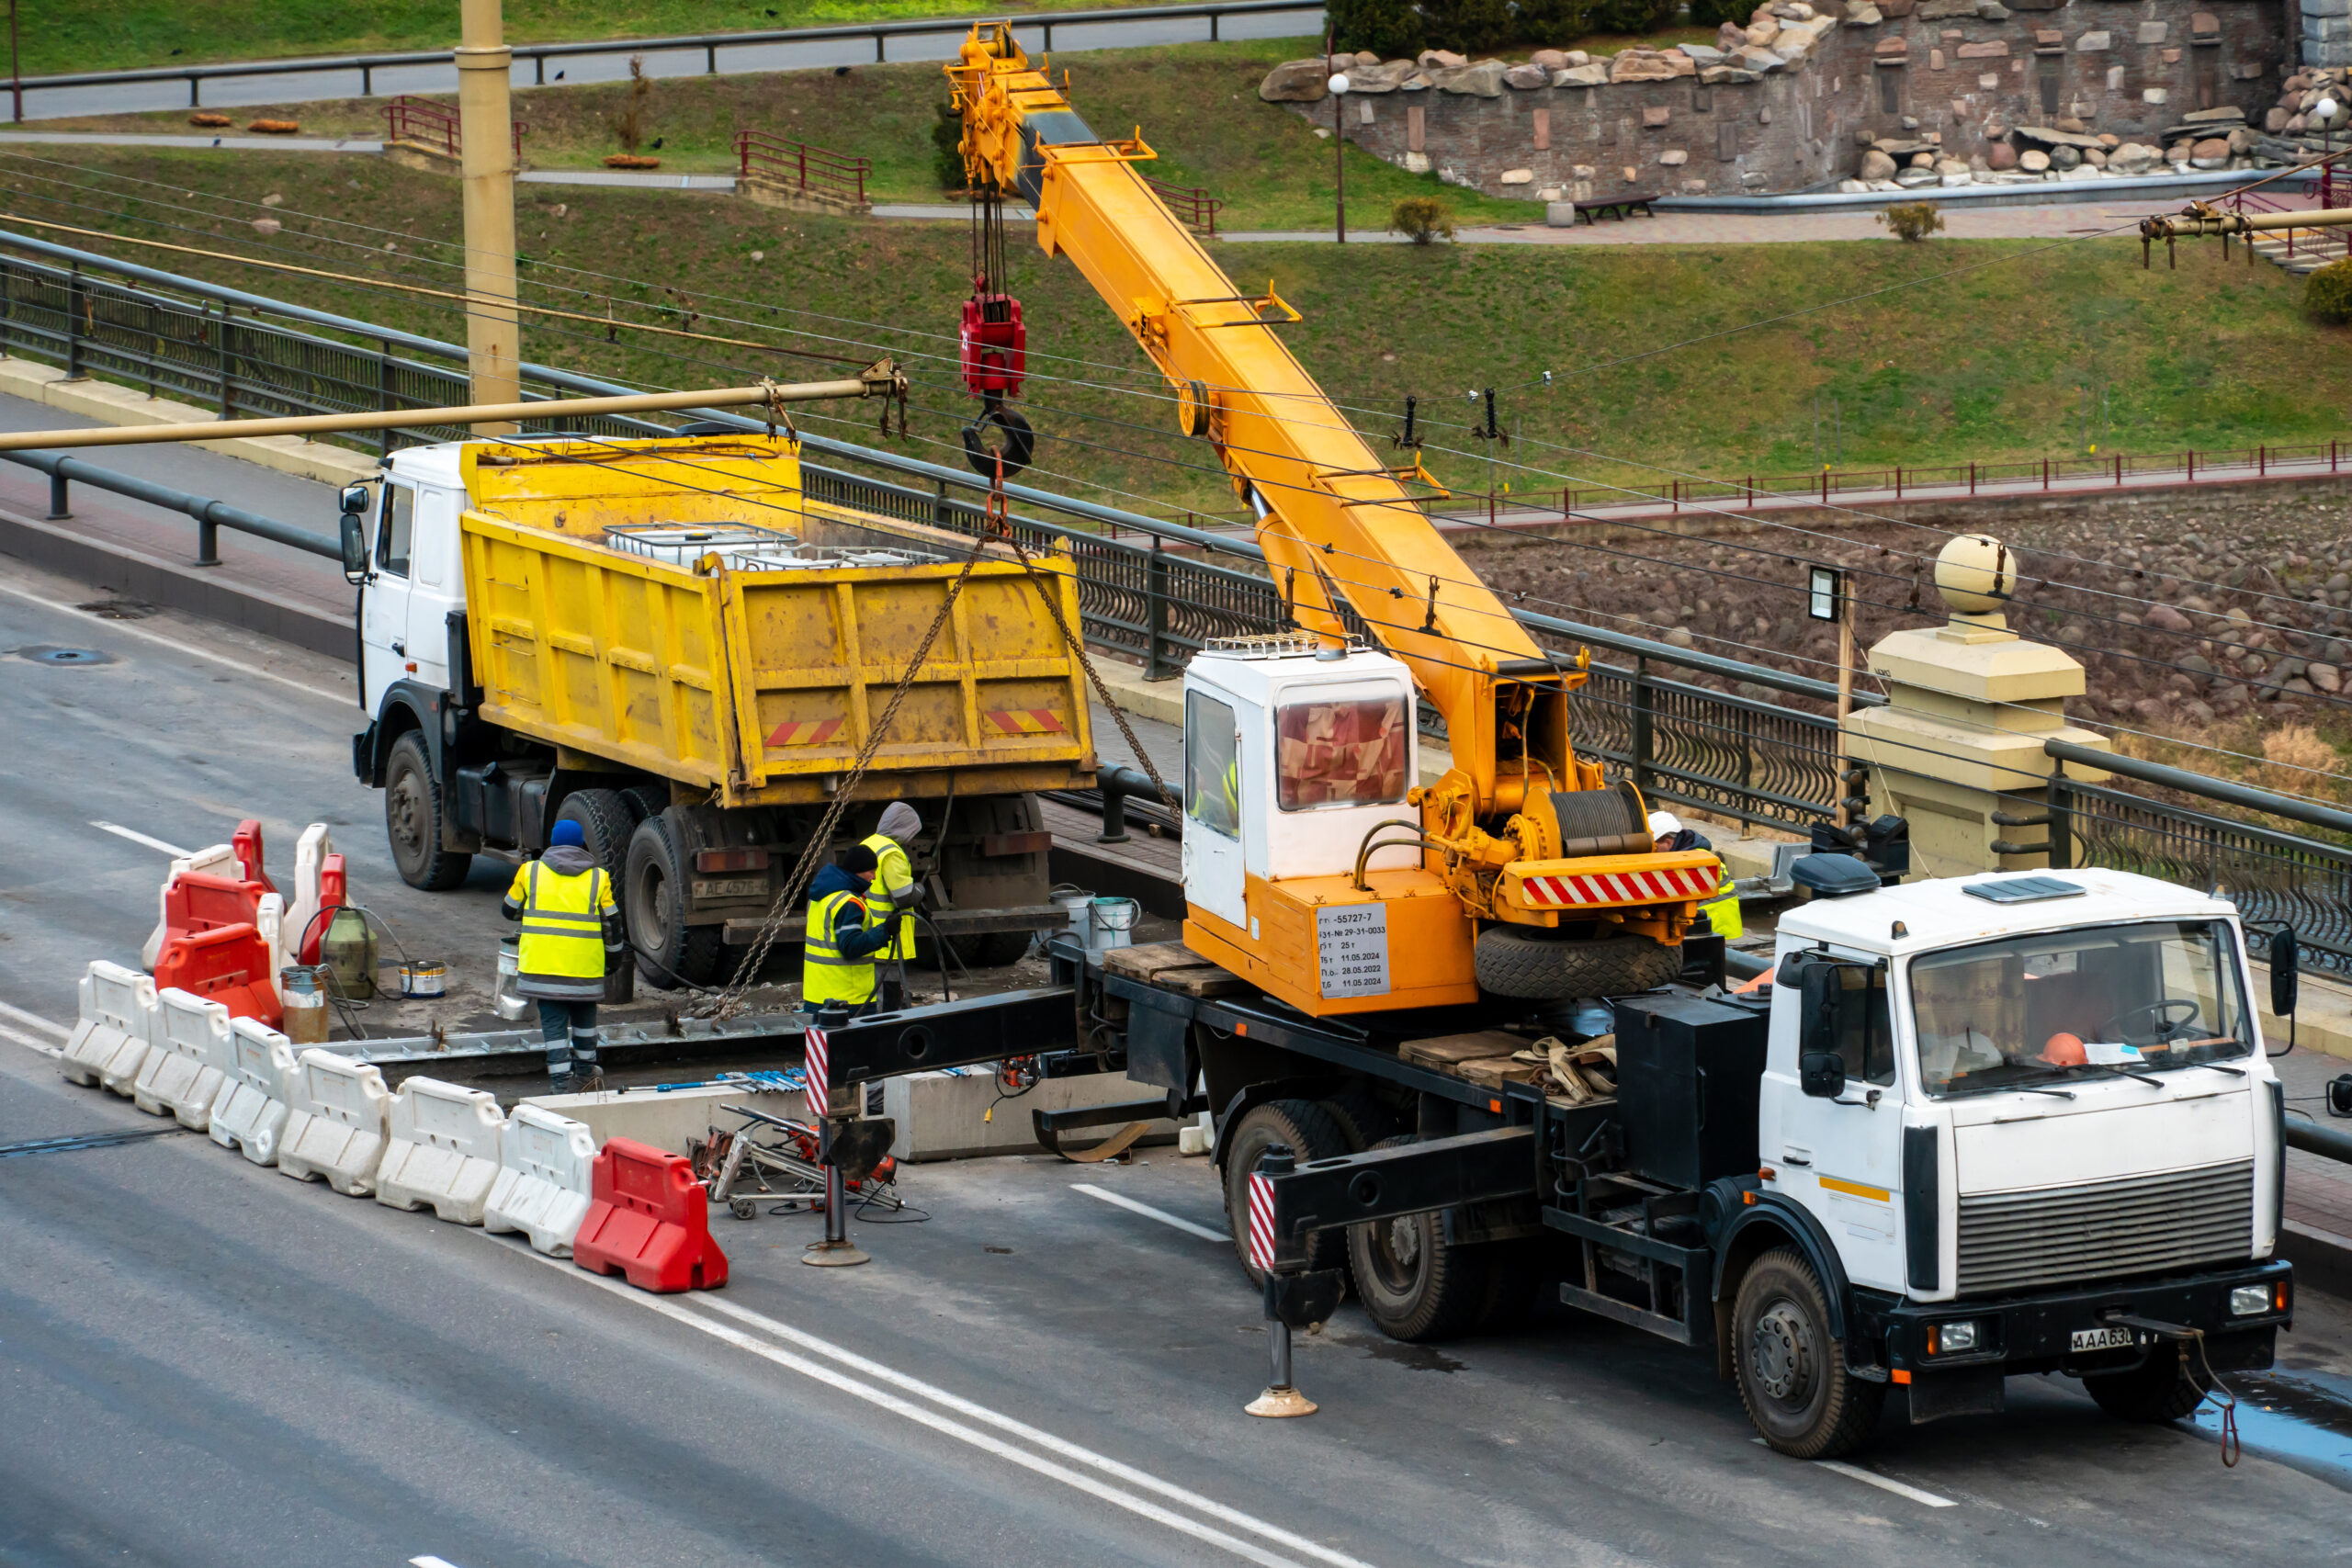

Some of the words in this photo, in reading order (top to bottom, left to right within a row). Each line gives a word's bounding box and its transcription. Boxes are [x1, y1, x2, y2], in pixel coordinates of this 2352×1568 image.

[1340, 942, 1351, 950] 25
[1341, 953, 1380, 962] 11.05.2024
[1341, 964, 1381, 975] 28.05.2022
[1342, 977, 1382, 987] 11.05.2024
